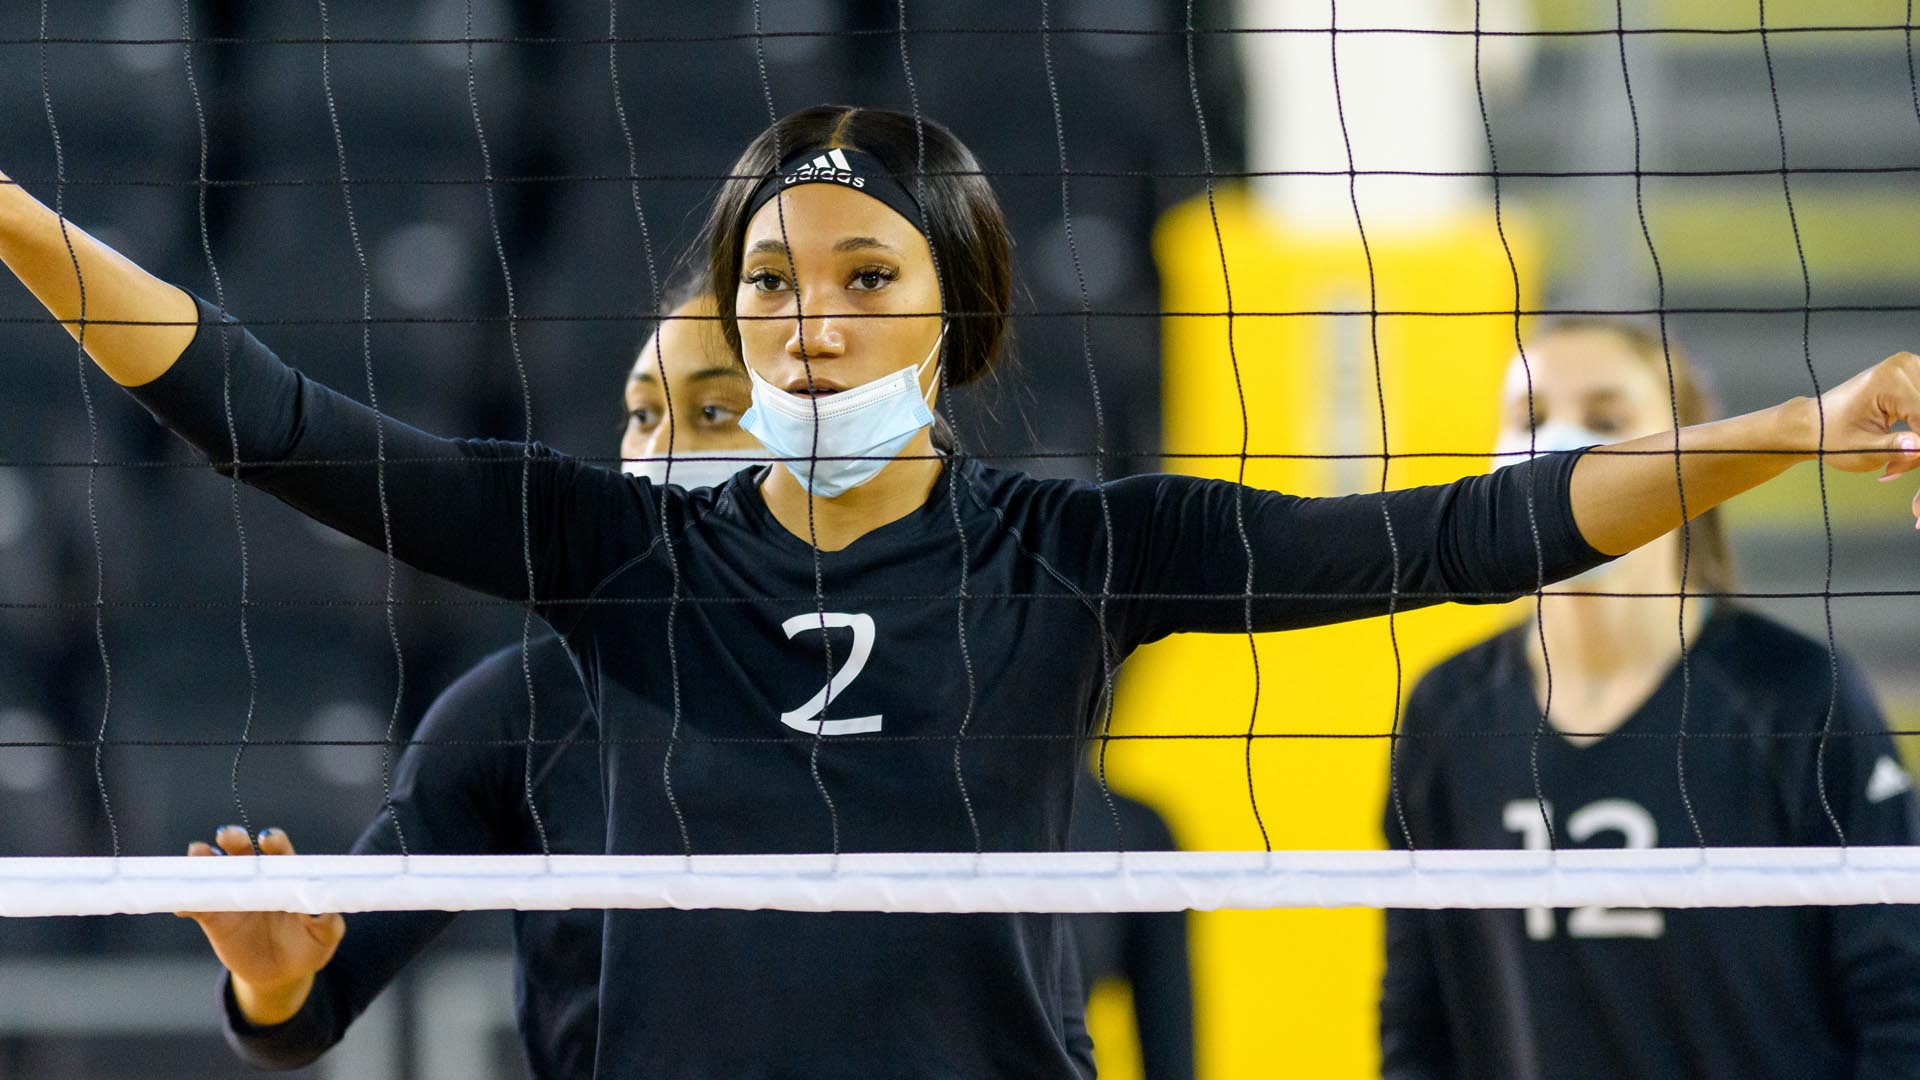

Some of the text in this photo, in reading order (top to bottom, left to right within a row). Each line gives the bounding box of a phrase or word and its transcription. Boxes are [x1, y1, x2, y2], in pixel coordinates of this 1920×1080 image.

[784, 167, 865, 188] adidas
[780, 612, 883, 736] 2
[1503, 798, 1665, 940] 12
